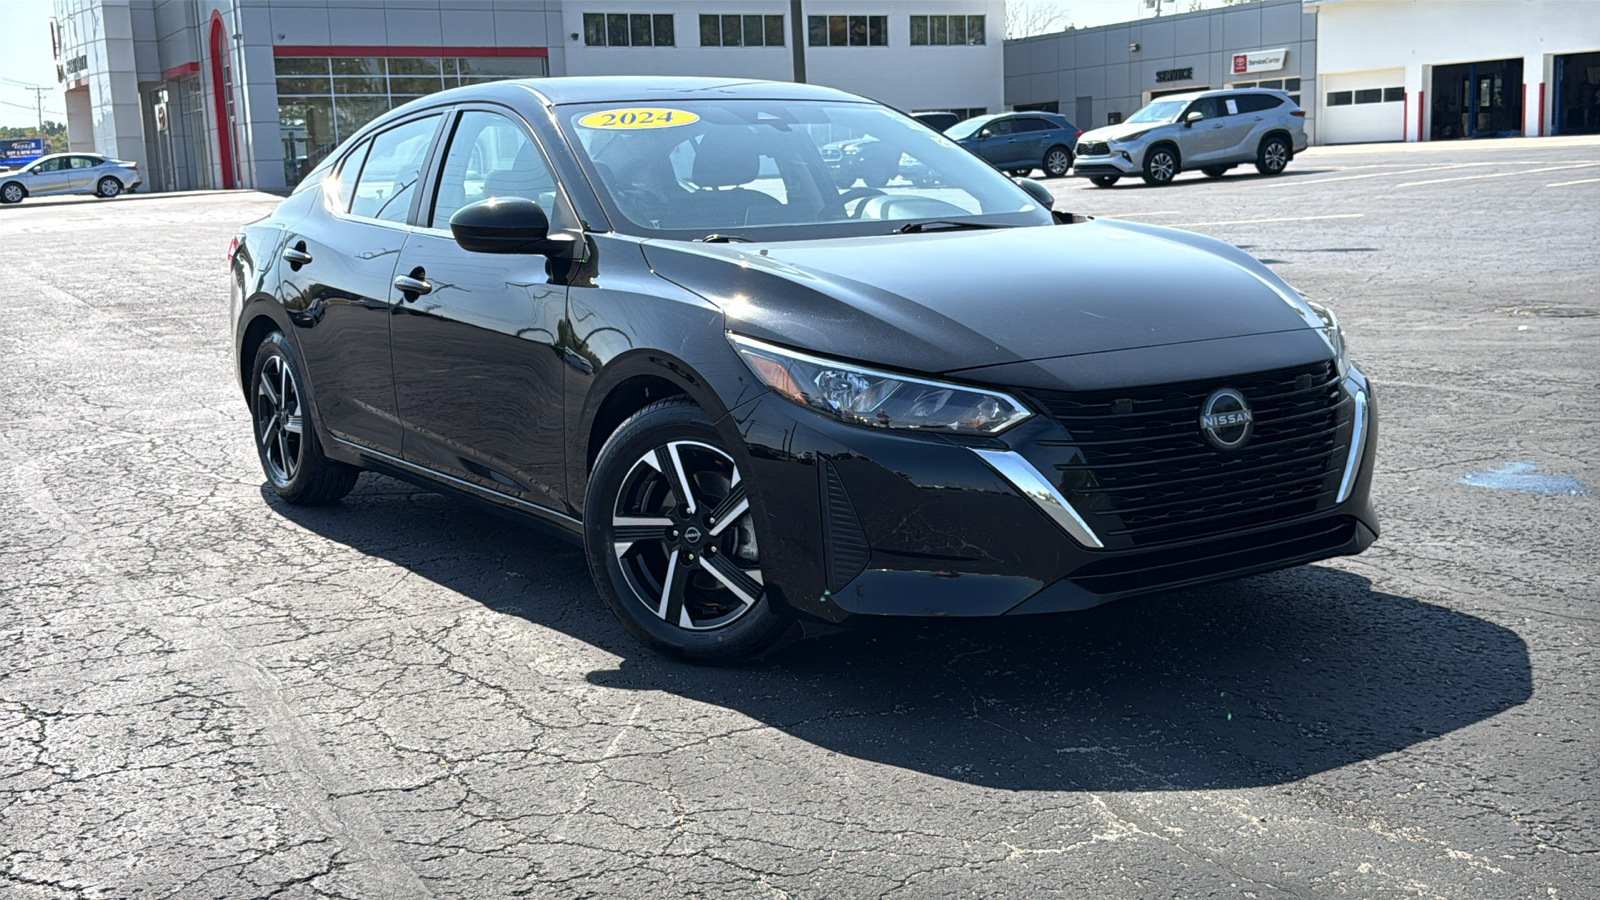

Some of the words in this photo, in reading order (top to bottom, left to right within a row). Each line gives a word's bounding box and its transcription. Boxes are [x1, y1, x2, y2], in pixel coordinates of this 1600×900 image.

[1155, 67, 1193, 83] SERVICE
[600, 111, 674, 126] 2024
[1203, 412, 1252, 427] NISSAN
